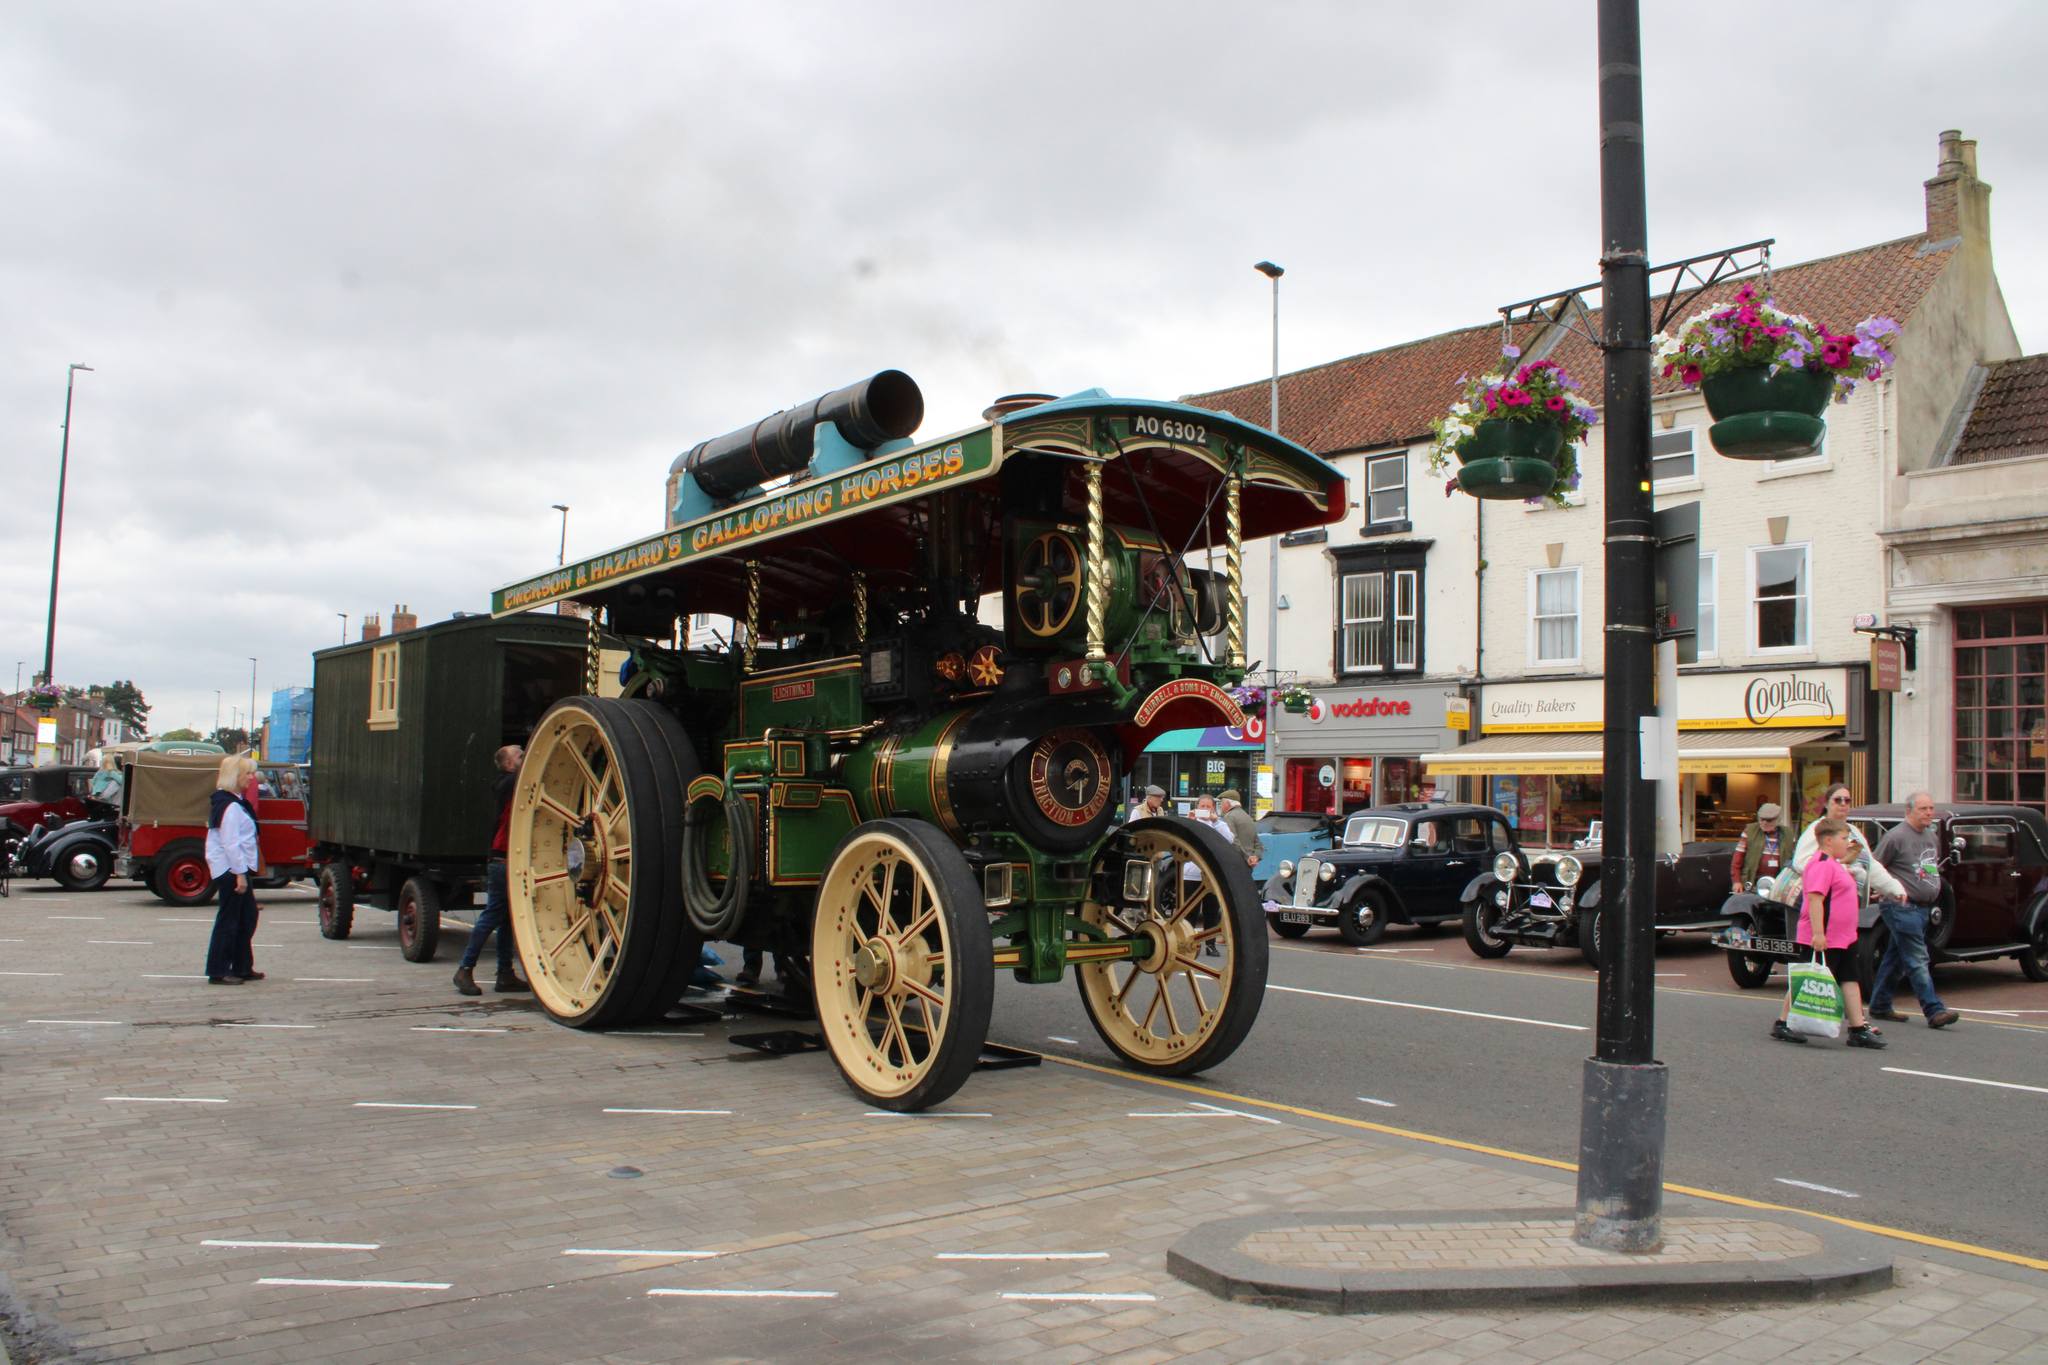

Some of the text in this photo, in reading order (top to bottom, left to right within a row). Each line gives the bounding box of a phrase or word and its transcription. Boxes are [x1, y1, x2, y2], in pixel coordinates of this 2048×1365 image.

[1135, 416, 1206, 444] AO 6302
[503, 442, 964, 609] EMERSON & HAZARD'S GALLOPING HORSES
[1145, 687, 1173, 715] BURRELL
[1180, 683, 1199, 693] SONS
[1210, 688, 1243, 725] ENGINEERS
[1331, 697, 1411, 718] vodafone
[1491, 698, 1577, 718] Quality Bakers
[1744, 673, 1834, 725] Cooplands
[1206, 760, 1226, 773] BIG
[1033, 776, 1110, 824] TRACTION ENGINE
[1282, 912, 1296, 921] ELU
[1756, 940, 1794, 953] BG 1368
[1800, 978, 1837, 999] ASDA
